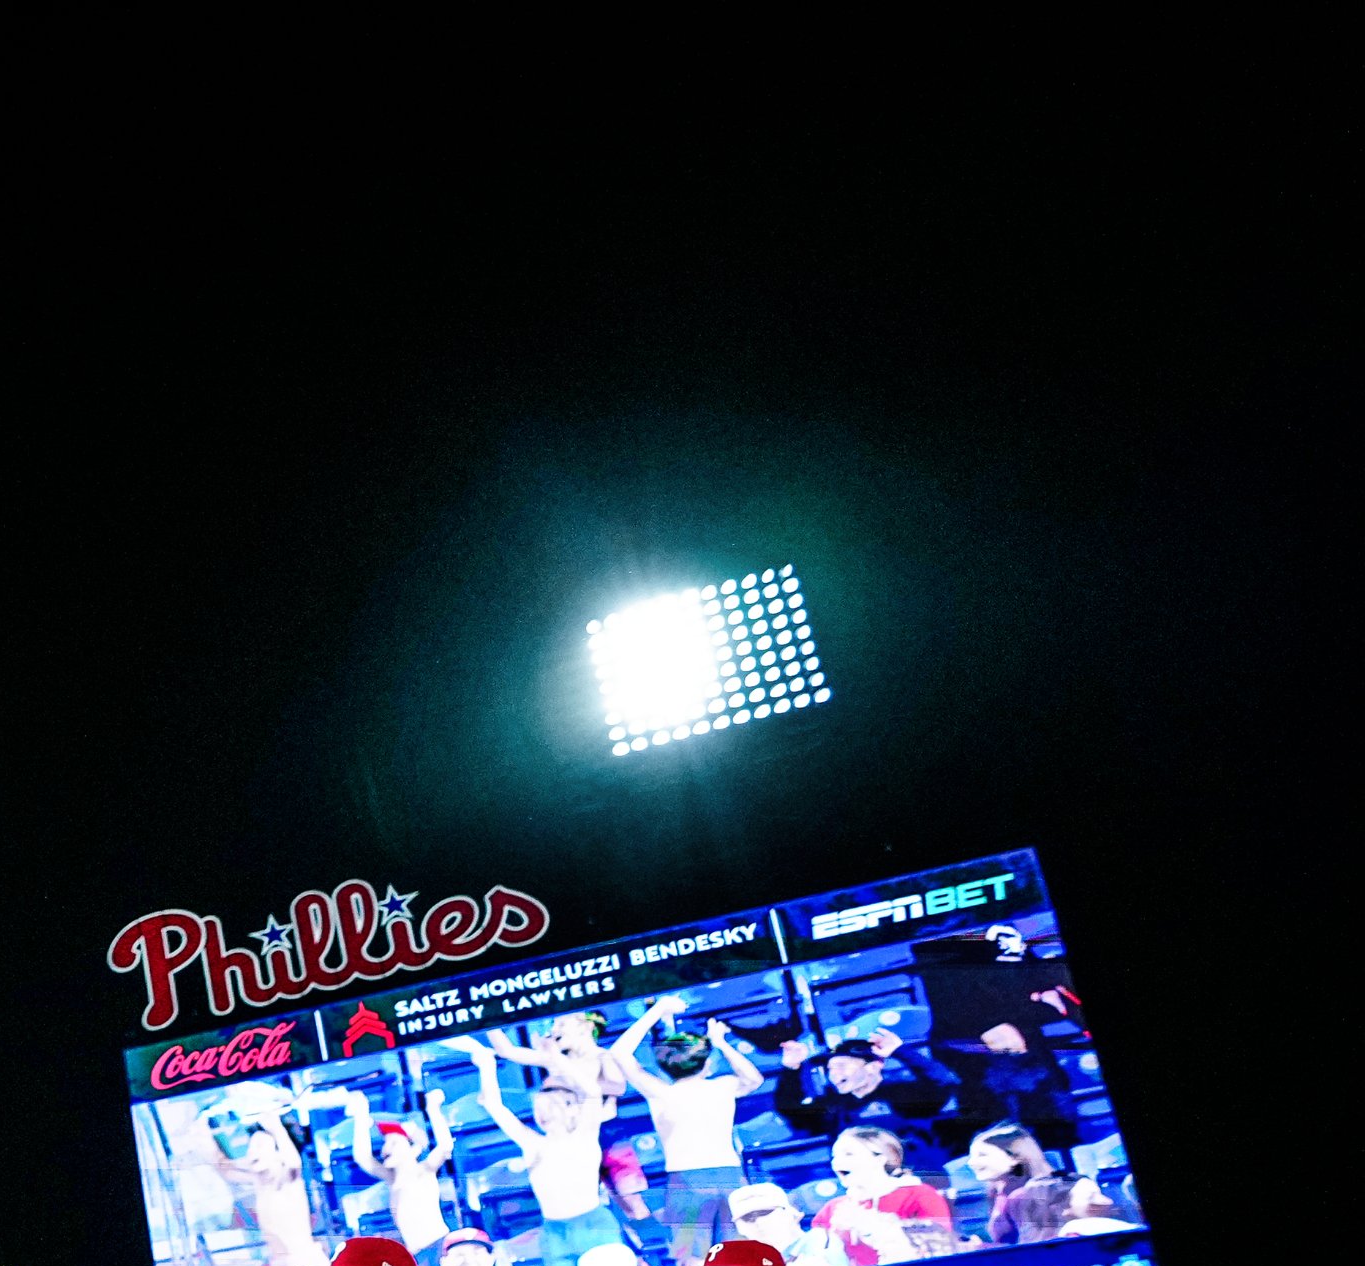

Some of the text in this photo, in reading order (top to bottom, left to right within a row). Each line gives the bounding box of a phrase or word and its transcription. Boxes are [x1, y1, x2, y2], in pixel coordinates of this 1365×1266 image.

[811, 873, 1015, 940] ESPN BET
[107, 879, 550, 1031] Phillies
[395, 922, 757, 1018] SALTZ MONGELUZZI BENDESKY
[398, 976, 616, 1035] INJURY LAWYERS
[150, 1020, 297, 1091] Coca-Cola
